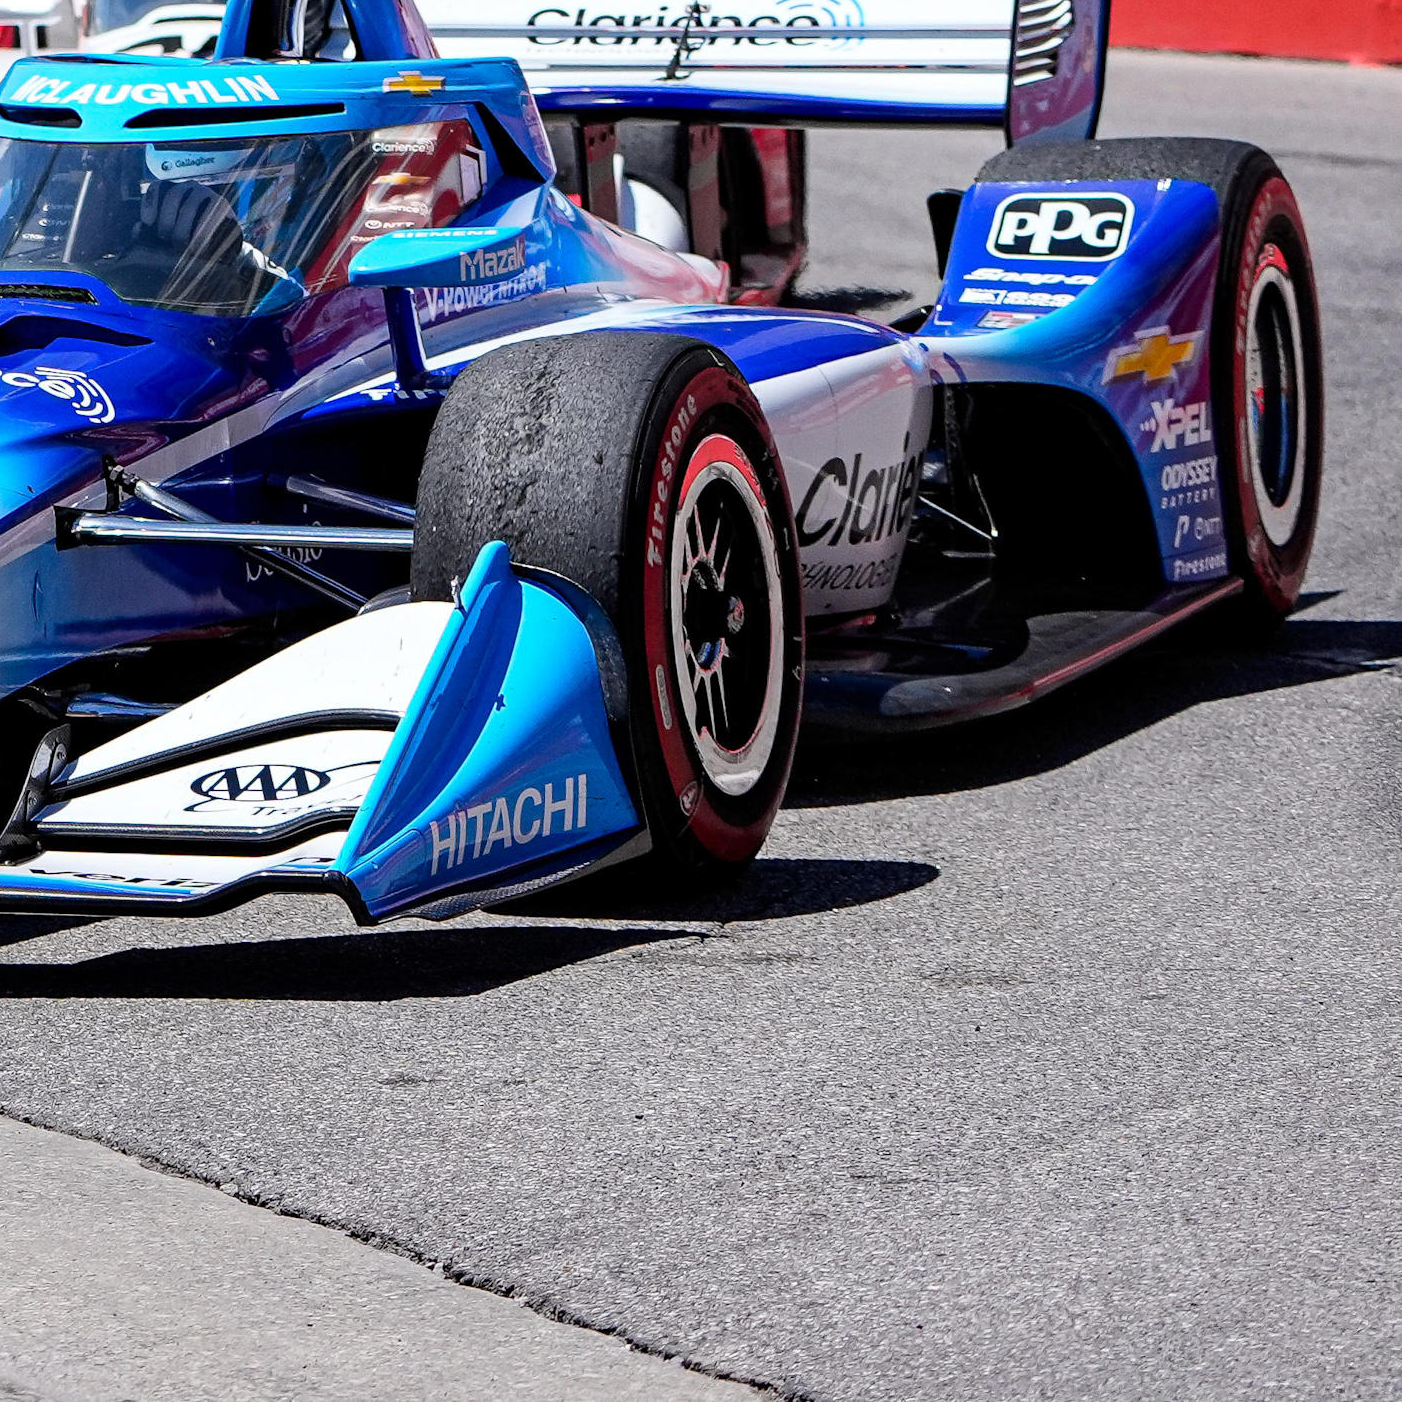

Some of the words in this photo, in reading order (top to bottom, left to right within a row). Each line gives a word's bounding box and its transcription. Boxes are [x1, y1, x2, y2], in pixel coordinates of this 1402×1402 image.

[526, 8, 821, 45] Clarience
[174, 154, 216, 168] Gallagher
[371, 140, 427, 154] Clarience
[392, 229, 497, 239] SIEMENS
[997, 202, 1124, 254] PPG
[459, 239, 526, 282] Mazak
[1150, 398, 1212, 453] XPEL
[647, 394, 697, 559] Firestone
[1161, 455, 1218, 491] ODYSSEY
[205, 765, 310, 801] AAA
[429, 773, 588, 877] HITACHI
